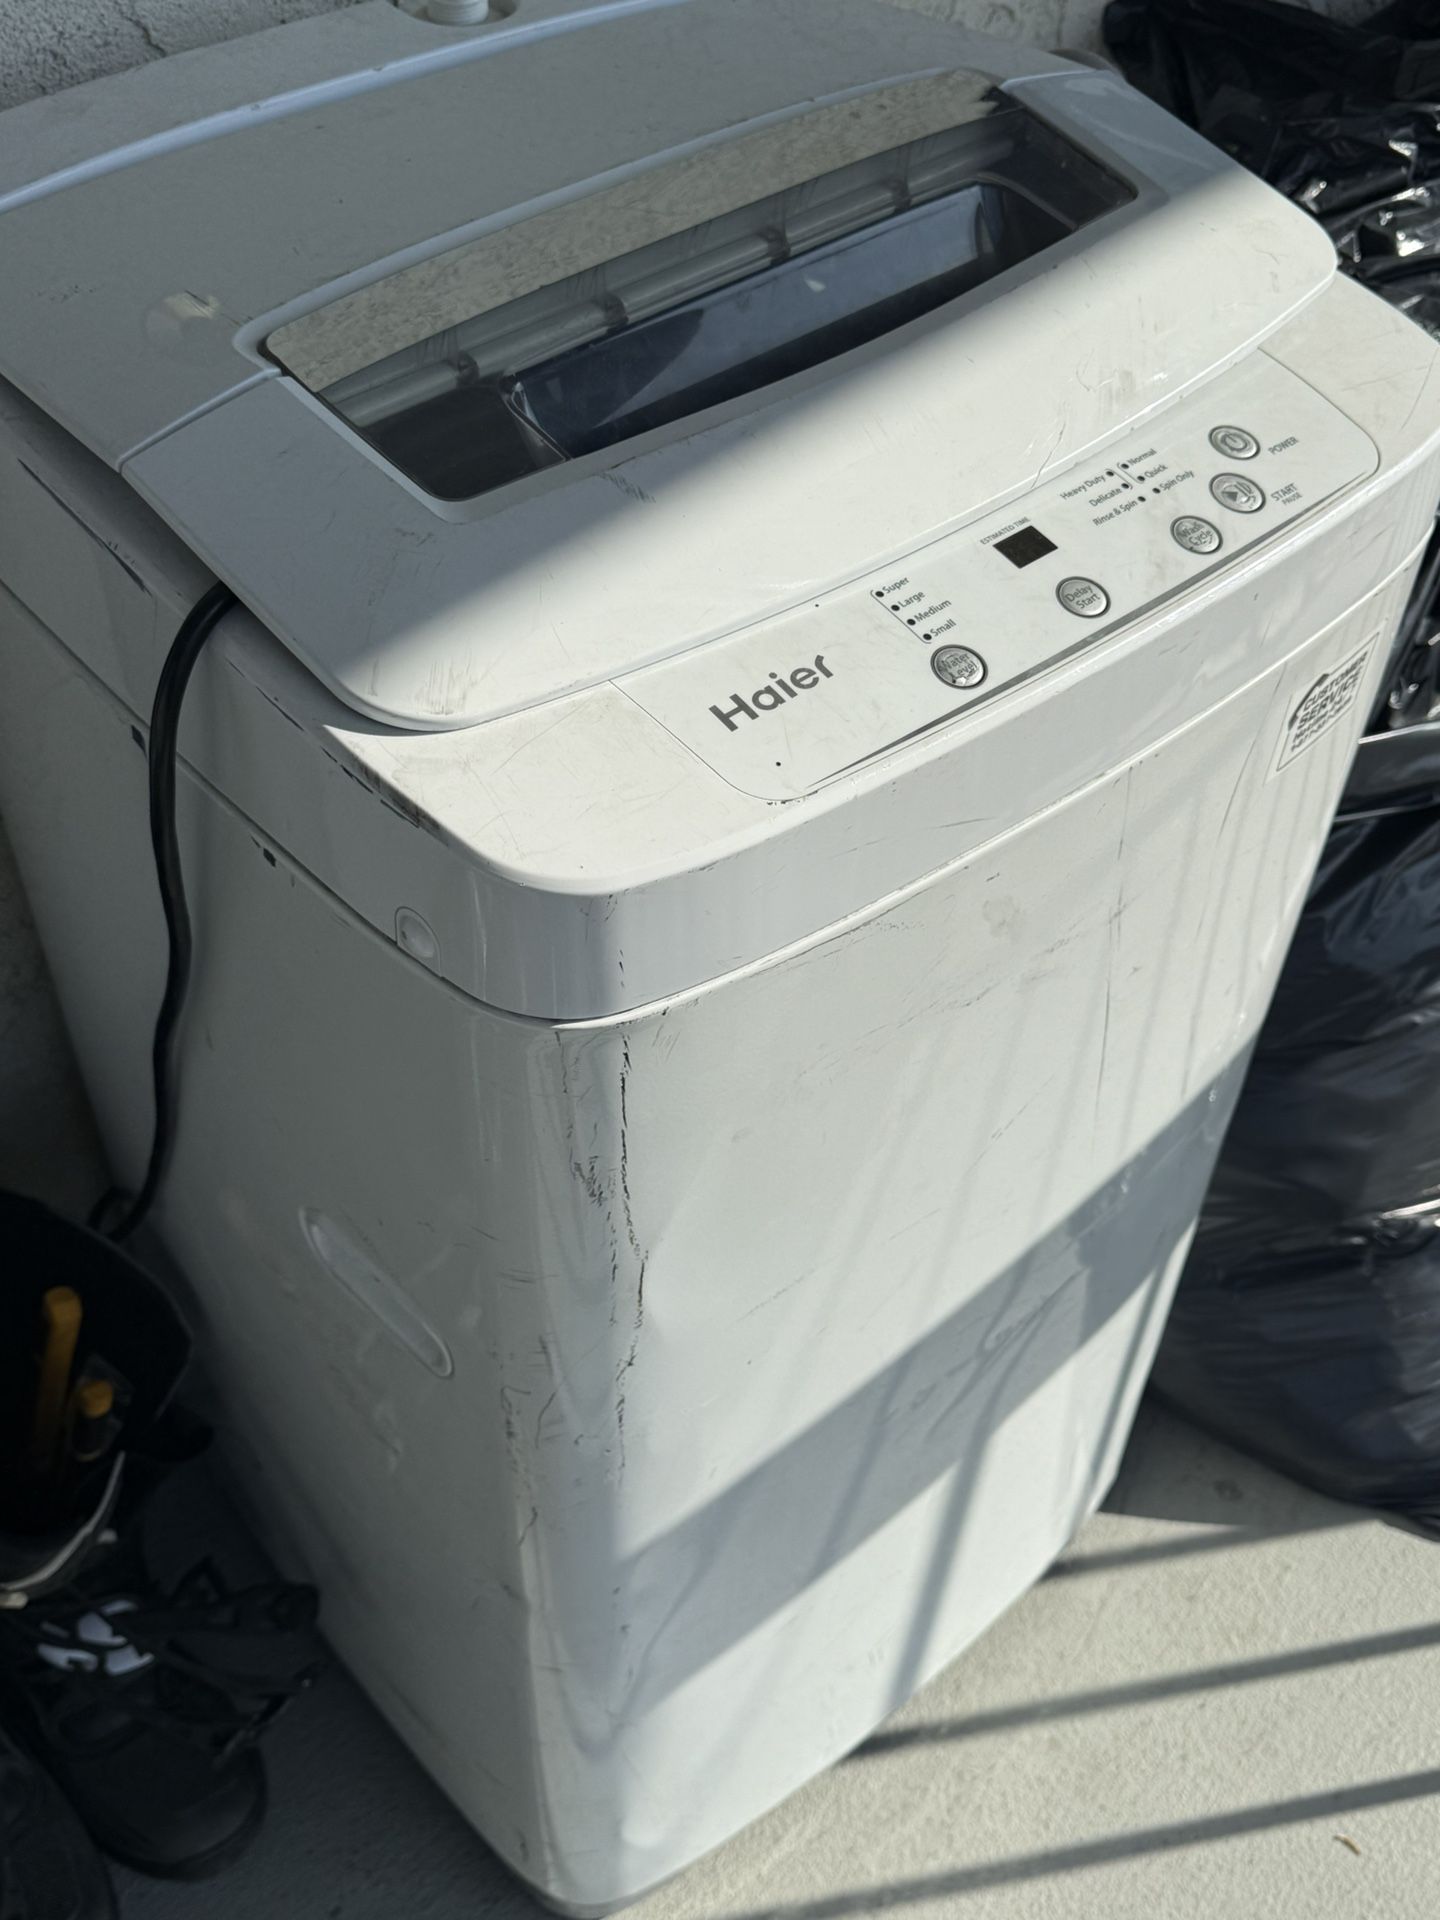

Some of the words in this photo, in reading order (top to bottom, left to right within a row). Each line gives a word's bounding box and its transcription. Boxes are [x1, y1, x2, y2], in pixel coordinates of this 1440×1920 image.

[1268, 436, 1299, 455] POWER
[1127, 448, 1157, 465] Normal
[1144, 464, 1168, 478] Quick
[1060, 484, 1087, 500] Heavy
[1084, 475, 1106, 489] Duty
[1159, 478, 1177, 491] Spin
[1175, 470, 1195, 483] Only
[1088, 487, 1122, 507] Delicate
[1270, 483, 1298, 501] START
[1092, 510, 1115, 526] Rinse
[1120, 500, 1138, 513] Spin
[979, 524, 1016, 545] ESTIMATED
[1013, 516, 1031, 529] TIME
[882, 577, 909, 594] Super
[1064, 585, 1093, 603] Delay
[897, 591, 925, 608] Large
[1076, 592, 1101, 609] Start
[913, 600, 952, 622] Medium
[930, 619, 957, 637] Small
[939, 653, 969, 671] Water
[708, 654, 834, 732] Haier
